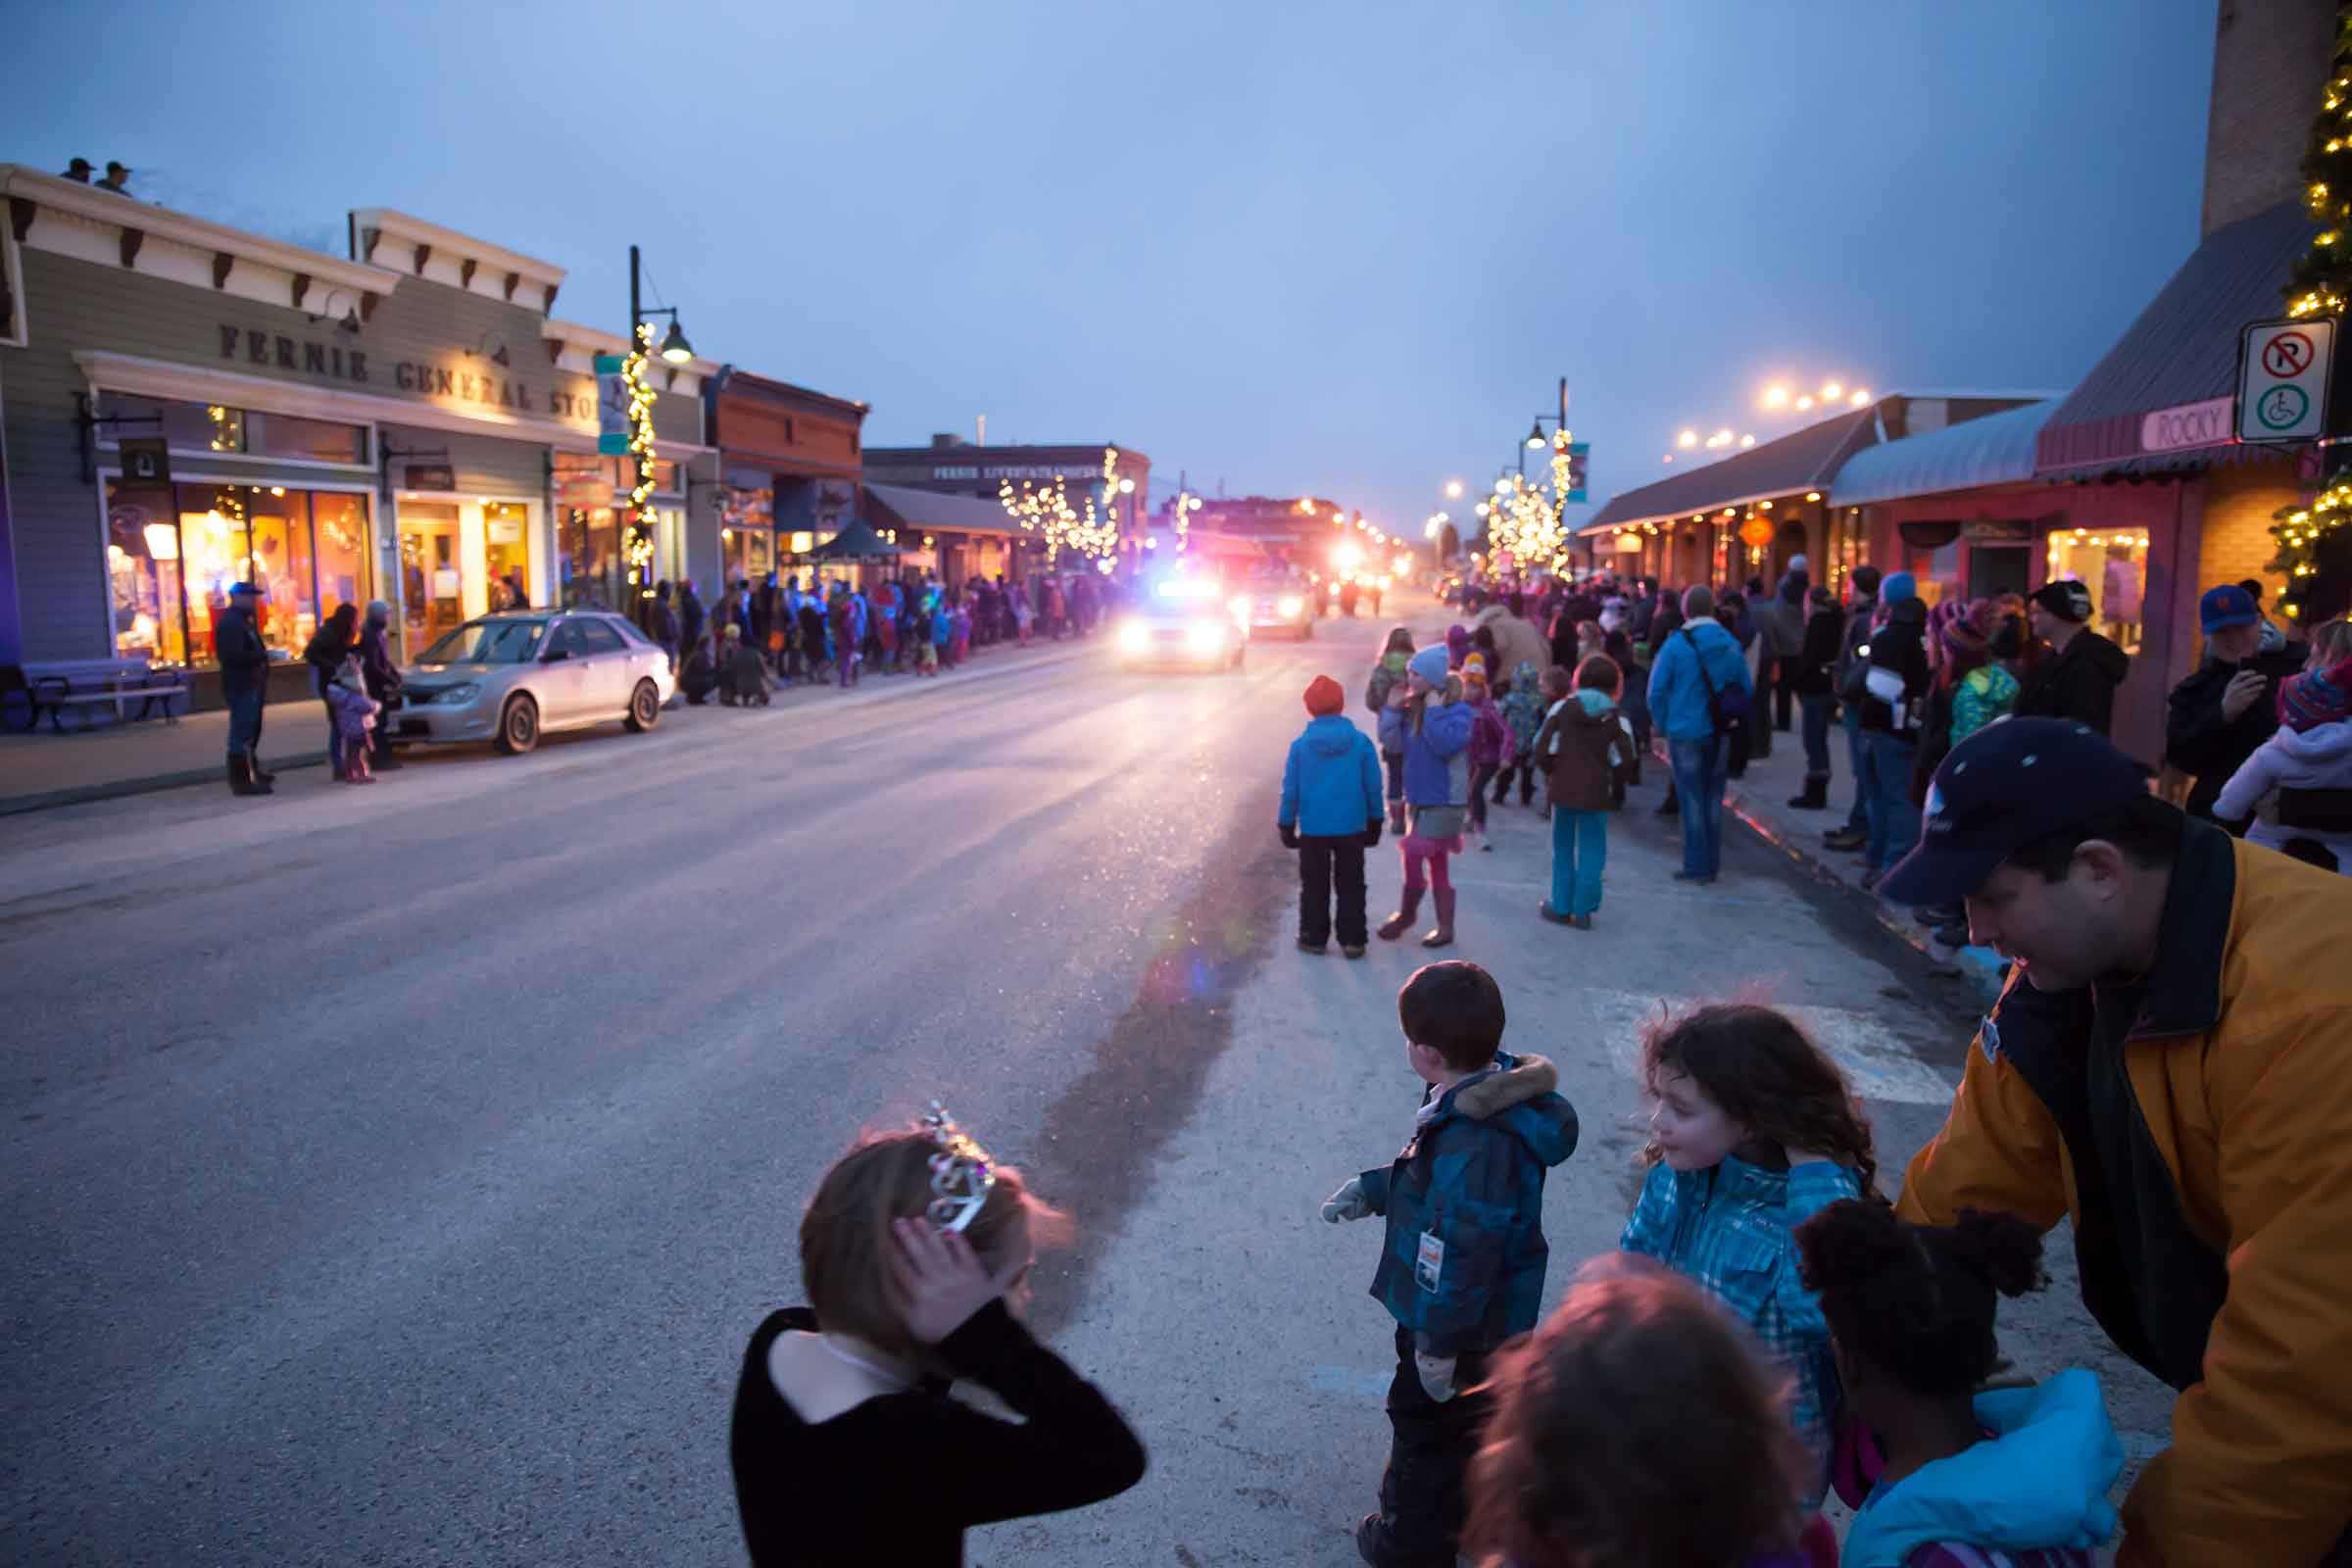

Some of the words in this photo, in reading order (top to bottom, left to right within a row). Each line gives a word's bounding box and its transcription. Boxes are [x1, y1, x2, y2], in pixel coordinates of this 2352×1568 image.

[220, 322, 368, 383] FERNIE
[395, 360, 531, 411] GENERAL
[550, 389, 599, 420] STO
[2158, 406, 2223, 445] ROCKY
